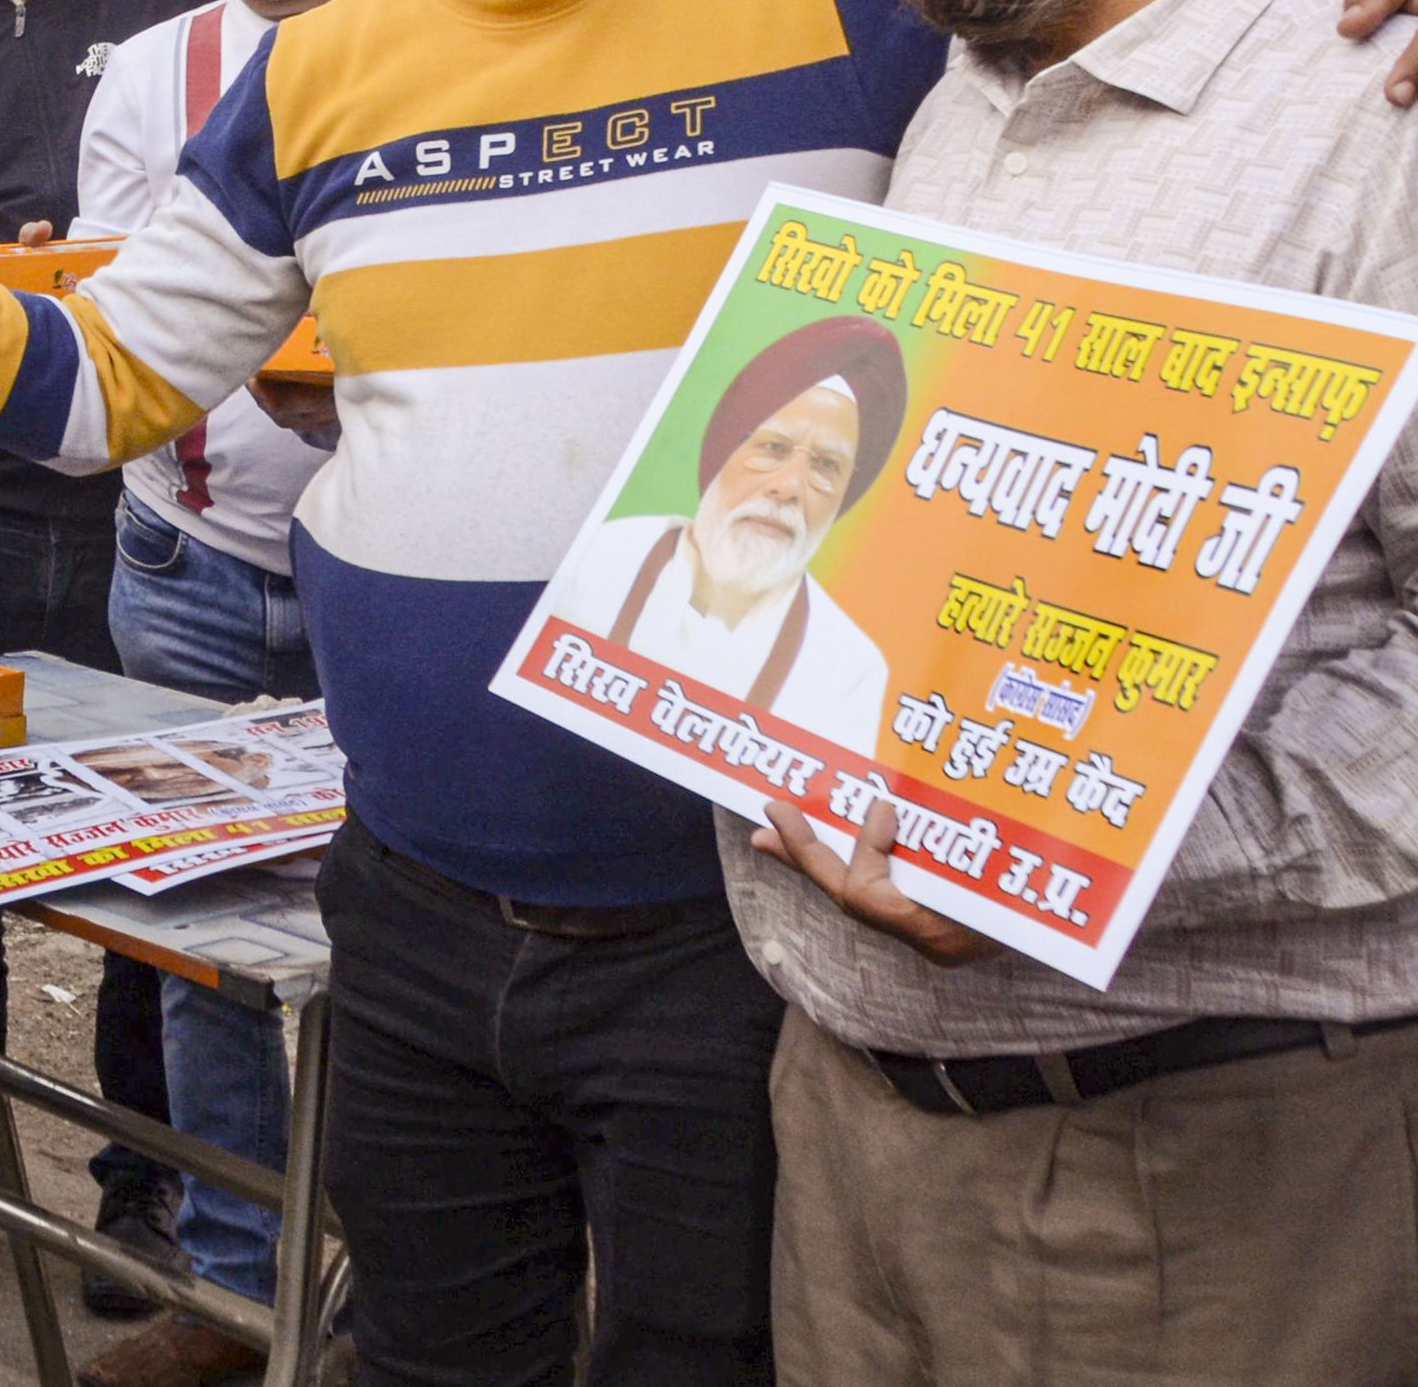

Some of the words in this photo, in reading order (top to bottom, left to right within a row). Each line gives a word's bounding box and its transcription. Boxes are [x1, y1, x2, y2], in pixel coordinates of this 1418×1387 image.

[354, 96, 716, 187] ASPECT
[498, 156, 615, 189] STREET
[626, 140, 716, 167] WEAR
[756, 219, 864, 303] सिखो
[857, 249, 922, 320] को
[910, 261, 1020, 348] मिला
[1015, 299, 1078, 362] 41
[1074, 311, 1167, 383] साल
[1159, 327, 1241, 398] बाद
[905, 407, 1098, 539] धन्यवाद
[1084, 432, 1216, 573] मोदी
[1195, 464, 1306, 597] जी
[937, 572, 1032, 649] हत्यारे
[1021, 599, 1129, 682] सज्जन
[1113, 629, 1220, 713] कुमार
[543, 633, 649, 715] सिख
[650, 678, 826, 797] वेलफेयर
[998, 845, 1093, 928] उ.प्र.
[892, 691, 955, 754] को
[943, 717, 1015, 780] हुई
[1004, 737, 1070, 798] उम्र
[1066, 750, 1147, 828] कैद
